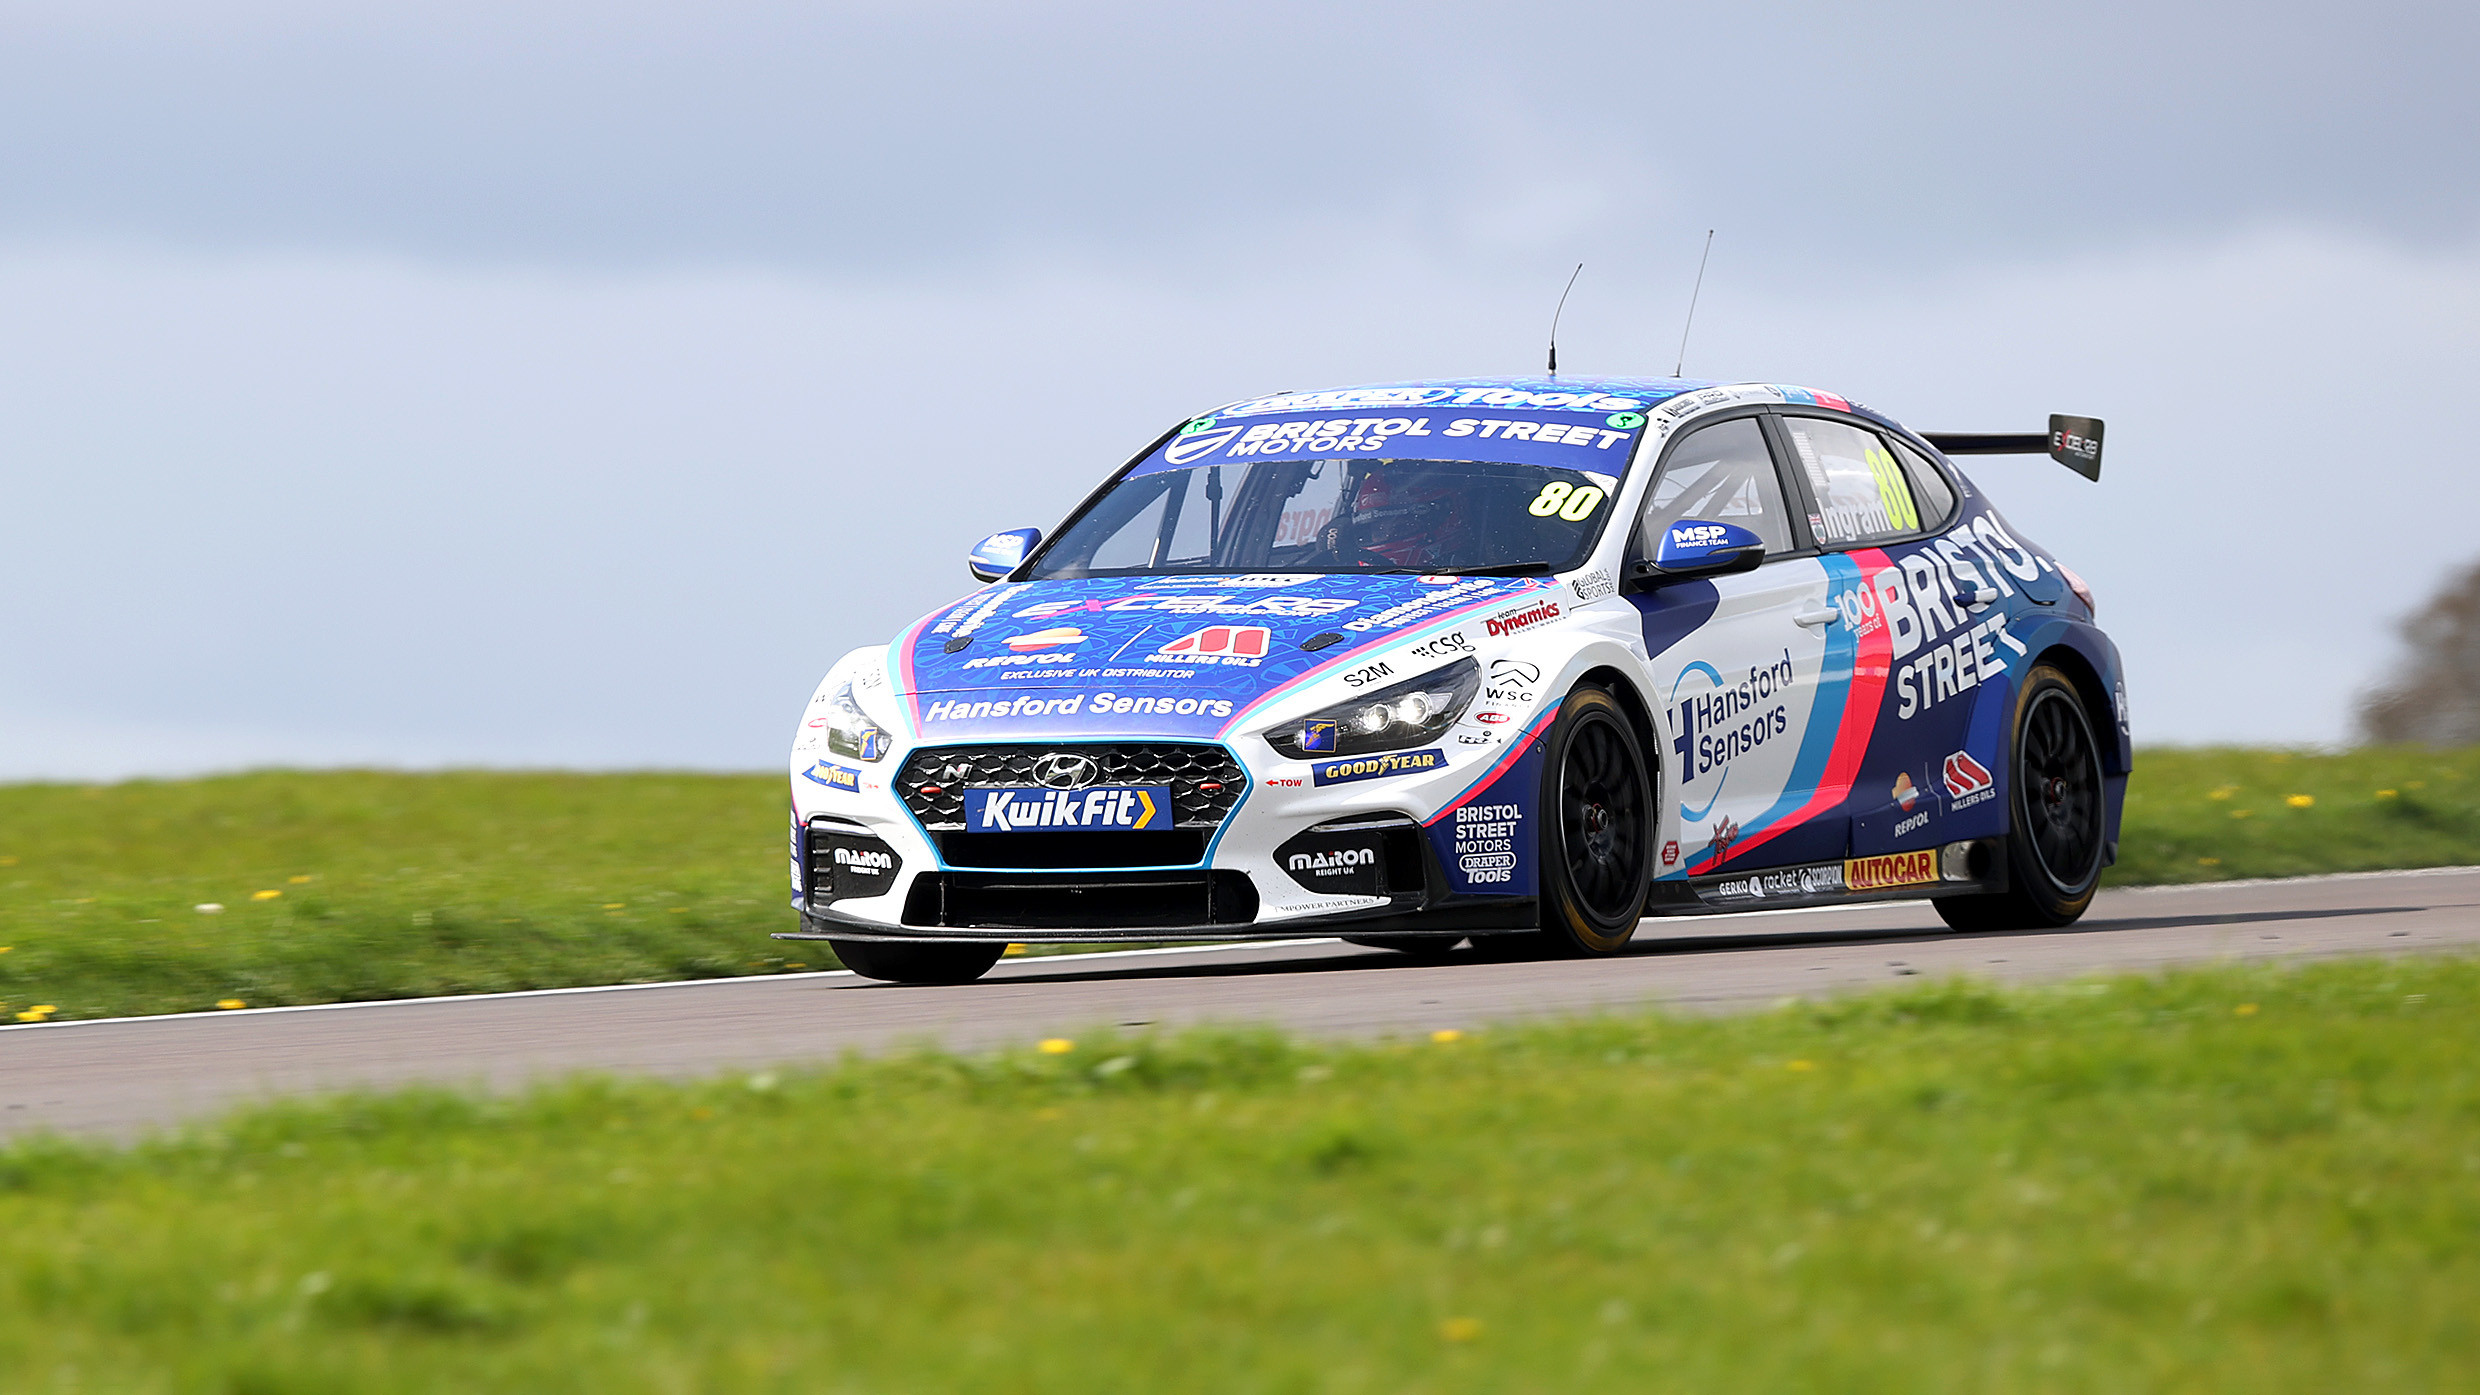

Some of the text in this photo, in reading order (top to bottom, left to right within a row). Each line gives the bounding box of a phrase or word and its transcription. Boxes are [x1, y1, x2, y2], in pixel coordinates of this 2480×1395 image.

[1452, 387, 1641, 410] Tools
[1240, 417, 1631, 450] BRISTOL STREET
[1226, 436, 1388, 457] MOTORS
[1864, 448, 1919, 531] 80
[1528, 481, 1604, 522] 80
[1815, 498, 1893, 541] Ingram
[1672, 525, 1726, 542] MSP
[1676, 540, 1707, 549] FINANCE
[1577, 569, 1606, 587] GLOBAL
[1583, 581, 1611, 600] SPORTS
[1498, 608, 1517, 619] team
[1834, 582, 1875, 632] 100
[1486, 600, 1560, 636] Dynamics
[1853, 613, 1882, 643] years of
[962, 652, 1077, 670] REPSOL
[1144, 653, 1263, 668] MILLERS OILS
[1898, 612, 2028, 720] STREET
[1000, 668, 1195, 680] EXCLUSIVE UK DISTRIBUTOR
[1344, 662, 1394, 687] S2M
[1486, 687, 1533, 702] WSC
[1696, 648, 1793, 734] Hansford
[925, 692, 1235, 723] Hansford Sensors
[1698, 705, 1787, 774] Sensors
[1325, 754, 1435, 779] GOODYEAR
[1280, 778, 1302, 787] TOW
[1951, 788, 1996, 812] MILLERS OILS
[1456, 804, 1522, 823] BRISTOL
[1456, 822, 1517, 840] STREET
[1894, 810, 1929, 839] REPSOL
[1455, 839, 1512, 854] MOTORS
[1343, 866, 1355, 876] UK
[1465, 854, 1511, 868] DRAPER
[1851, 853, 1932, 888] AUTOCAR
[1467, 868, 1511, 884] Tools
[1764, 869, 1797, 889] rocket
[1719, 880, 1748, 896] GERKO
[1325, 897, 1374, 907] PARTNERS
